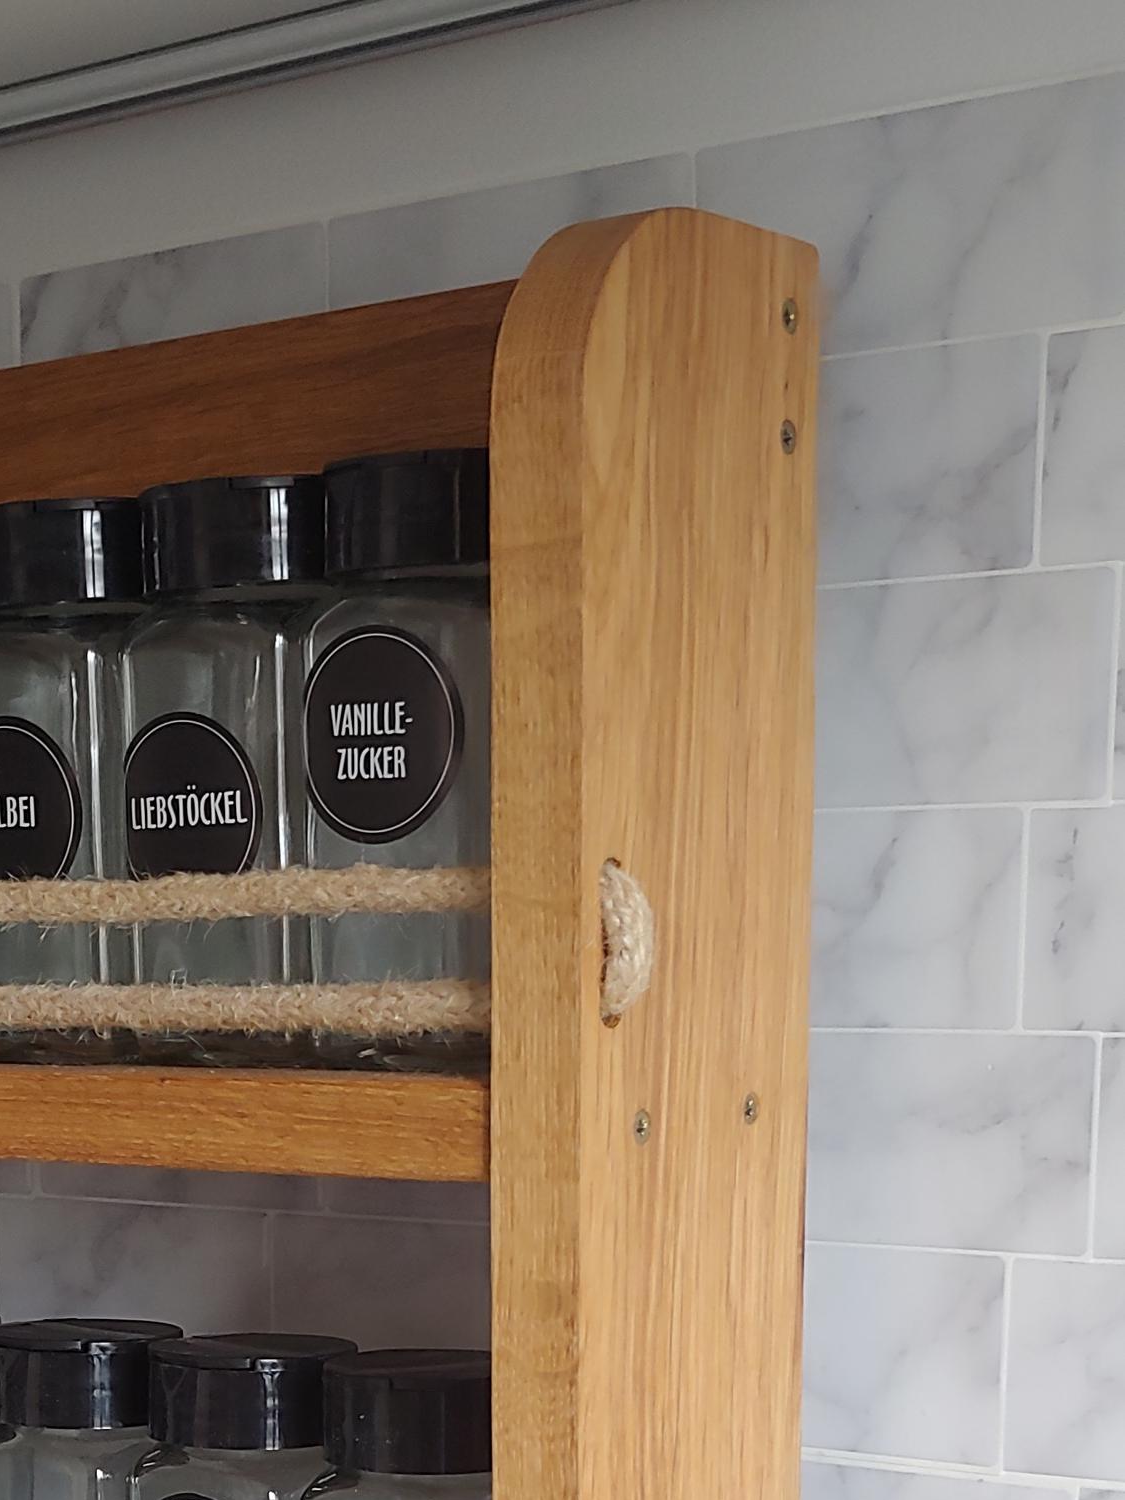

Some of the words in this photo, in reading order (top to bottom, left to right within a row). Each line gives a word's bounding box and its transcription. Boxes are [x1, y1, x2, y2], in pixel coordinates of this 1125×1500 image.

[330, 700, 413, 737] VANILLE-
[337, 745, 407, 781] ZUCKER
[131, 784, 248, 830] LIEBSTÖCKEL
